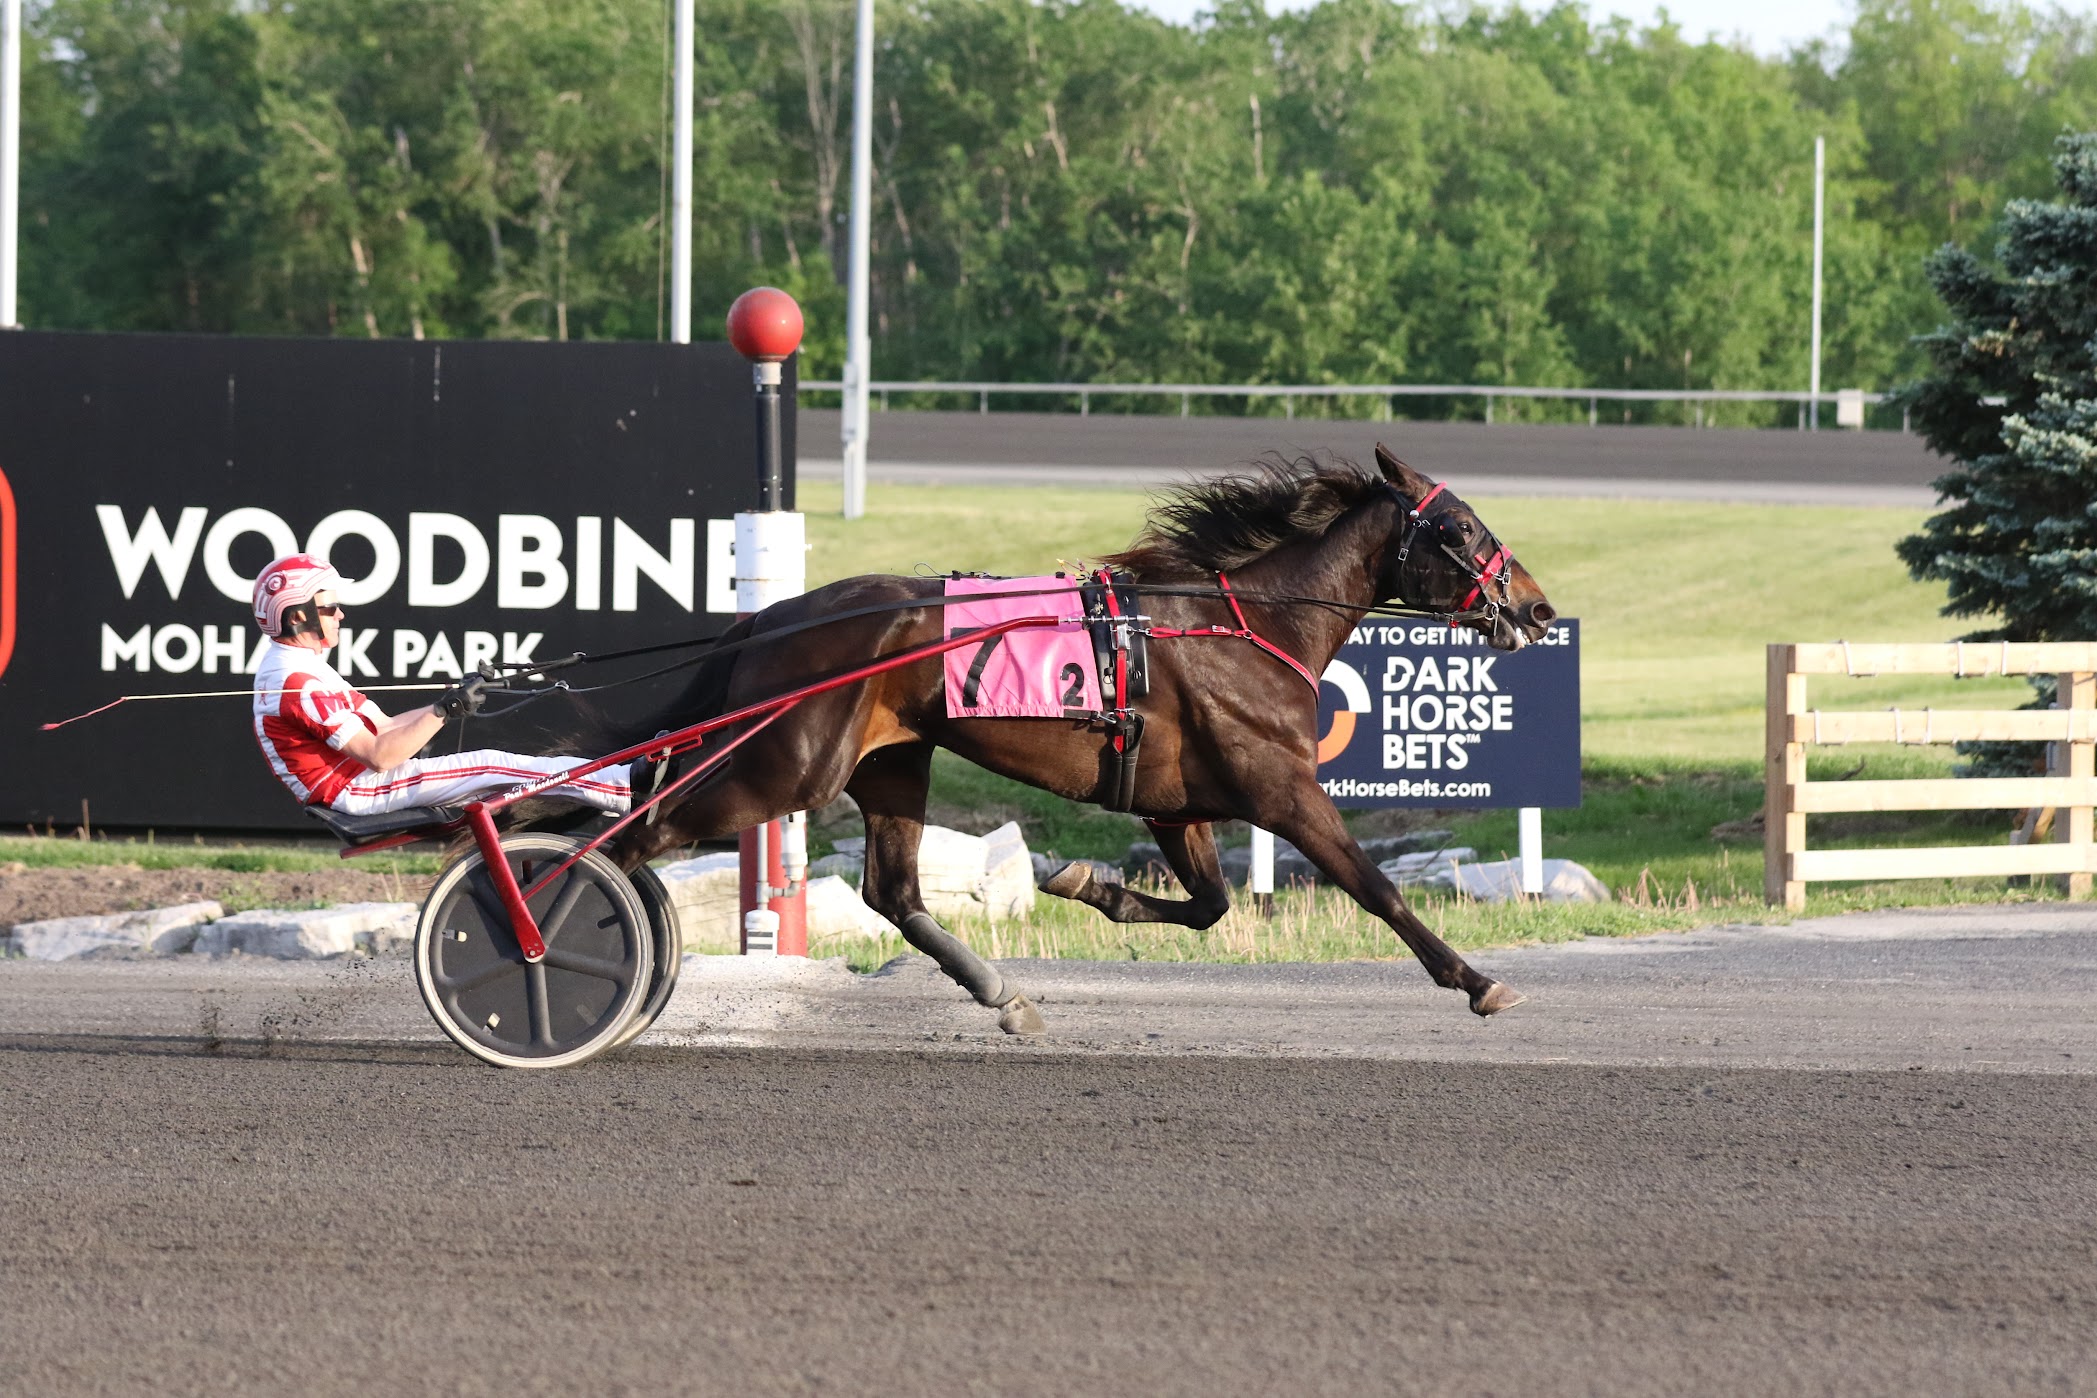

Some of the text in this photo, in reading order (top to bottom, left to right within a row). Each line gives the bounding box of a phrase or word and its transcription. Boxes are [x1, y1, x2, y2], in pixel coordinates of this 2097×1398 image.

[95, 504, 737, 613] WOODBINE
[101, 622, 545, 682] MOHK PARK
[1344, 626, 1375, 645] AY
[1378, 626, 1406, 645] TO
[1409, 626, 1448, 645] GET
[1451, 626, 1473, 645] IN
[950, 626, 1002, 707] 7
[1060, 663, 1085, 707] 2
[1382, 656, 1498, 692] DARK
[1382, 694, 1513, 731] HORSE
[1318, 778, 1491, 798] rkHorseBets.com
